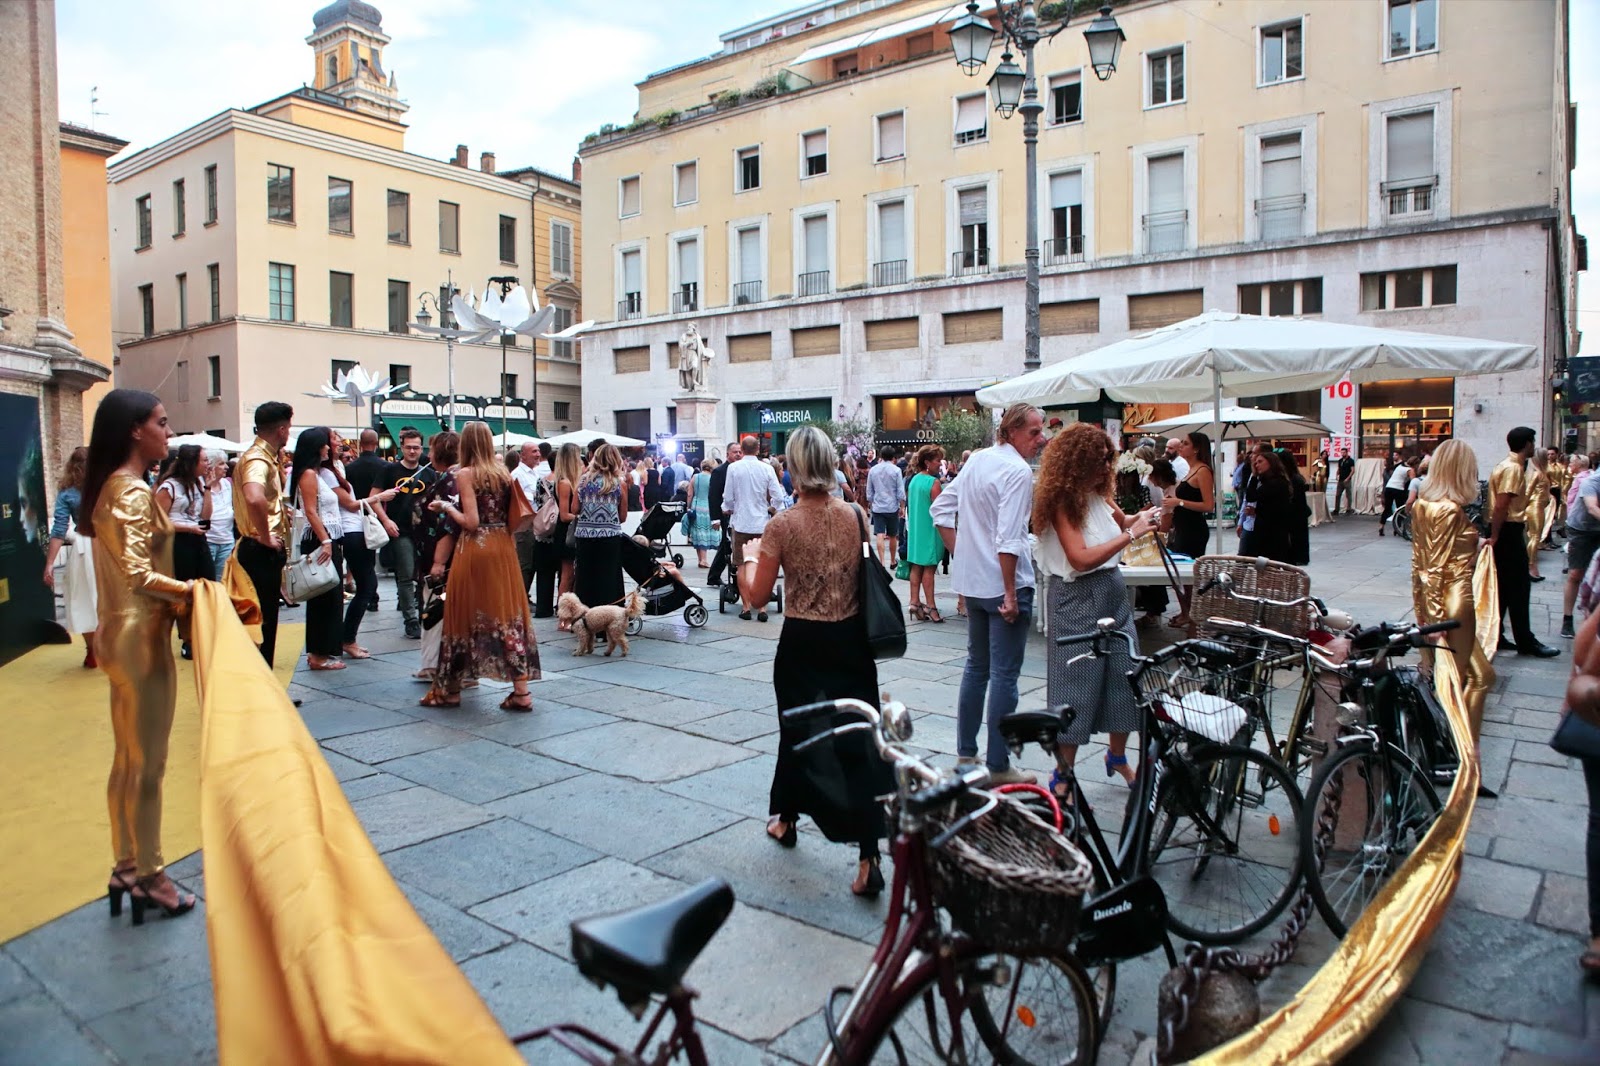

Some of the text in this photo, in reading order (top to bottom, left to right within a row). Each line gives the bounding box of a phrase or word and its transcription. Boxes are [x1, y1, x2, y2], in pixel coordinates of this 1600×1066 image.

[1325, 381, 1353, 399] 10
[445, 403, 475, 414] VNDER
[1093, 900, 1132, 920] Ducale
